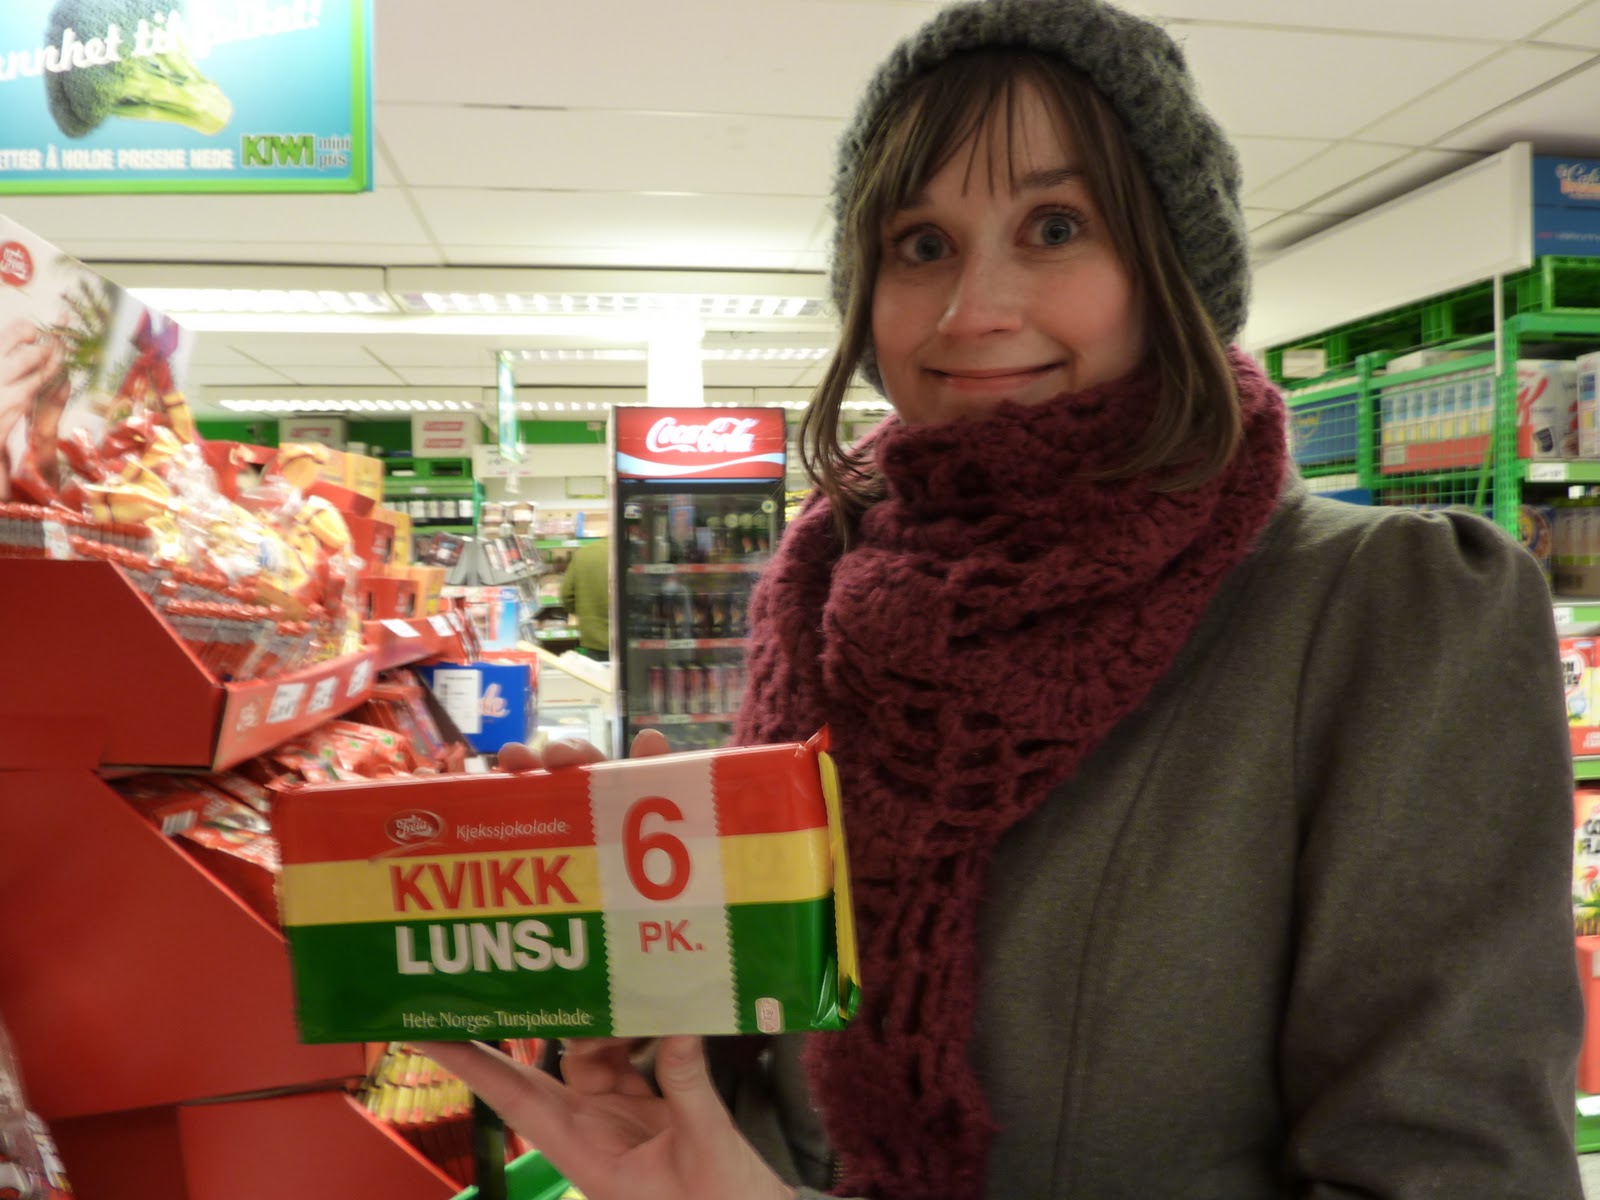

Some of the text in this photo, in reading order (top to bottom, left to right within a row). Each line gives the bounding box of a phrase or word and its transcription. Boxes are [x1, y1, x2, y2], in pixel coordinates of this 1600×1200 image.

[45, 143, 59, 170] Å
[61, 149, 115, 170] HOLDE
[117, 149, 187, 170] PRISENE
[189, 149, 234, 170] NEDE
[241, 134, 315, 167] KIWI
[319, 136, 351, 151] mini
[319, 153, 347, 170] pris
[646, 416, 760, 453] Coca-Cola
[395, 814, 433, 839] Freia
[456, 818, 567, 841] Kjekssjokolade
[621, 796, 691, 901] 6
[389, 855, 580, 912] KVIKK
[395, 918, 589, 975] LUNSJ
[638, 920, 705, 952] PK.
[402, 1008, 592, 1033] Hele Norges Tursjokolade
